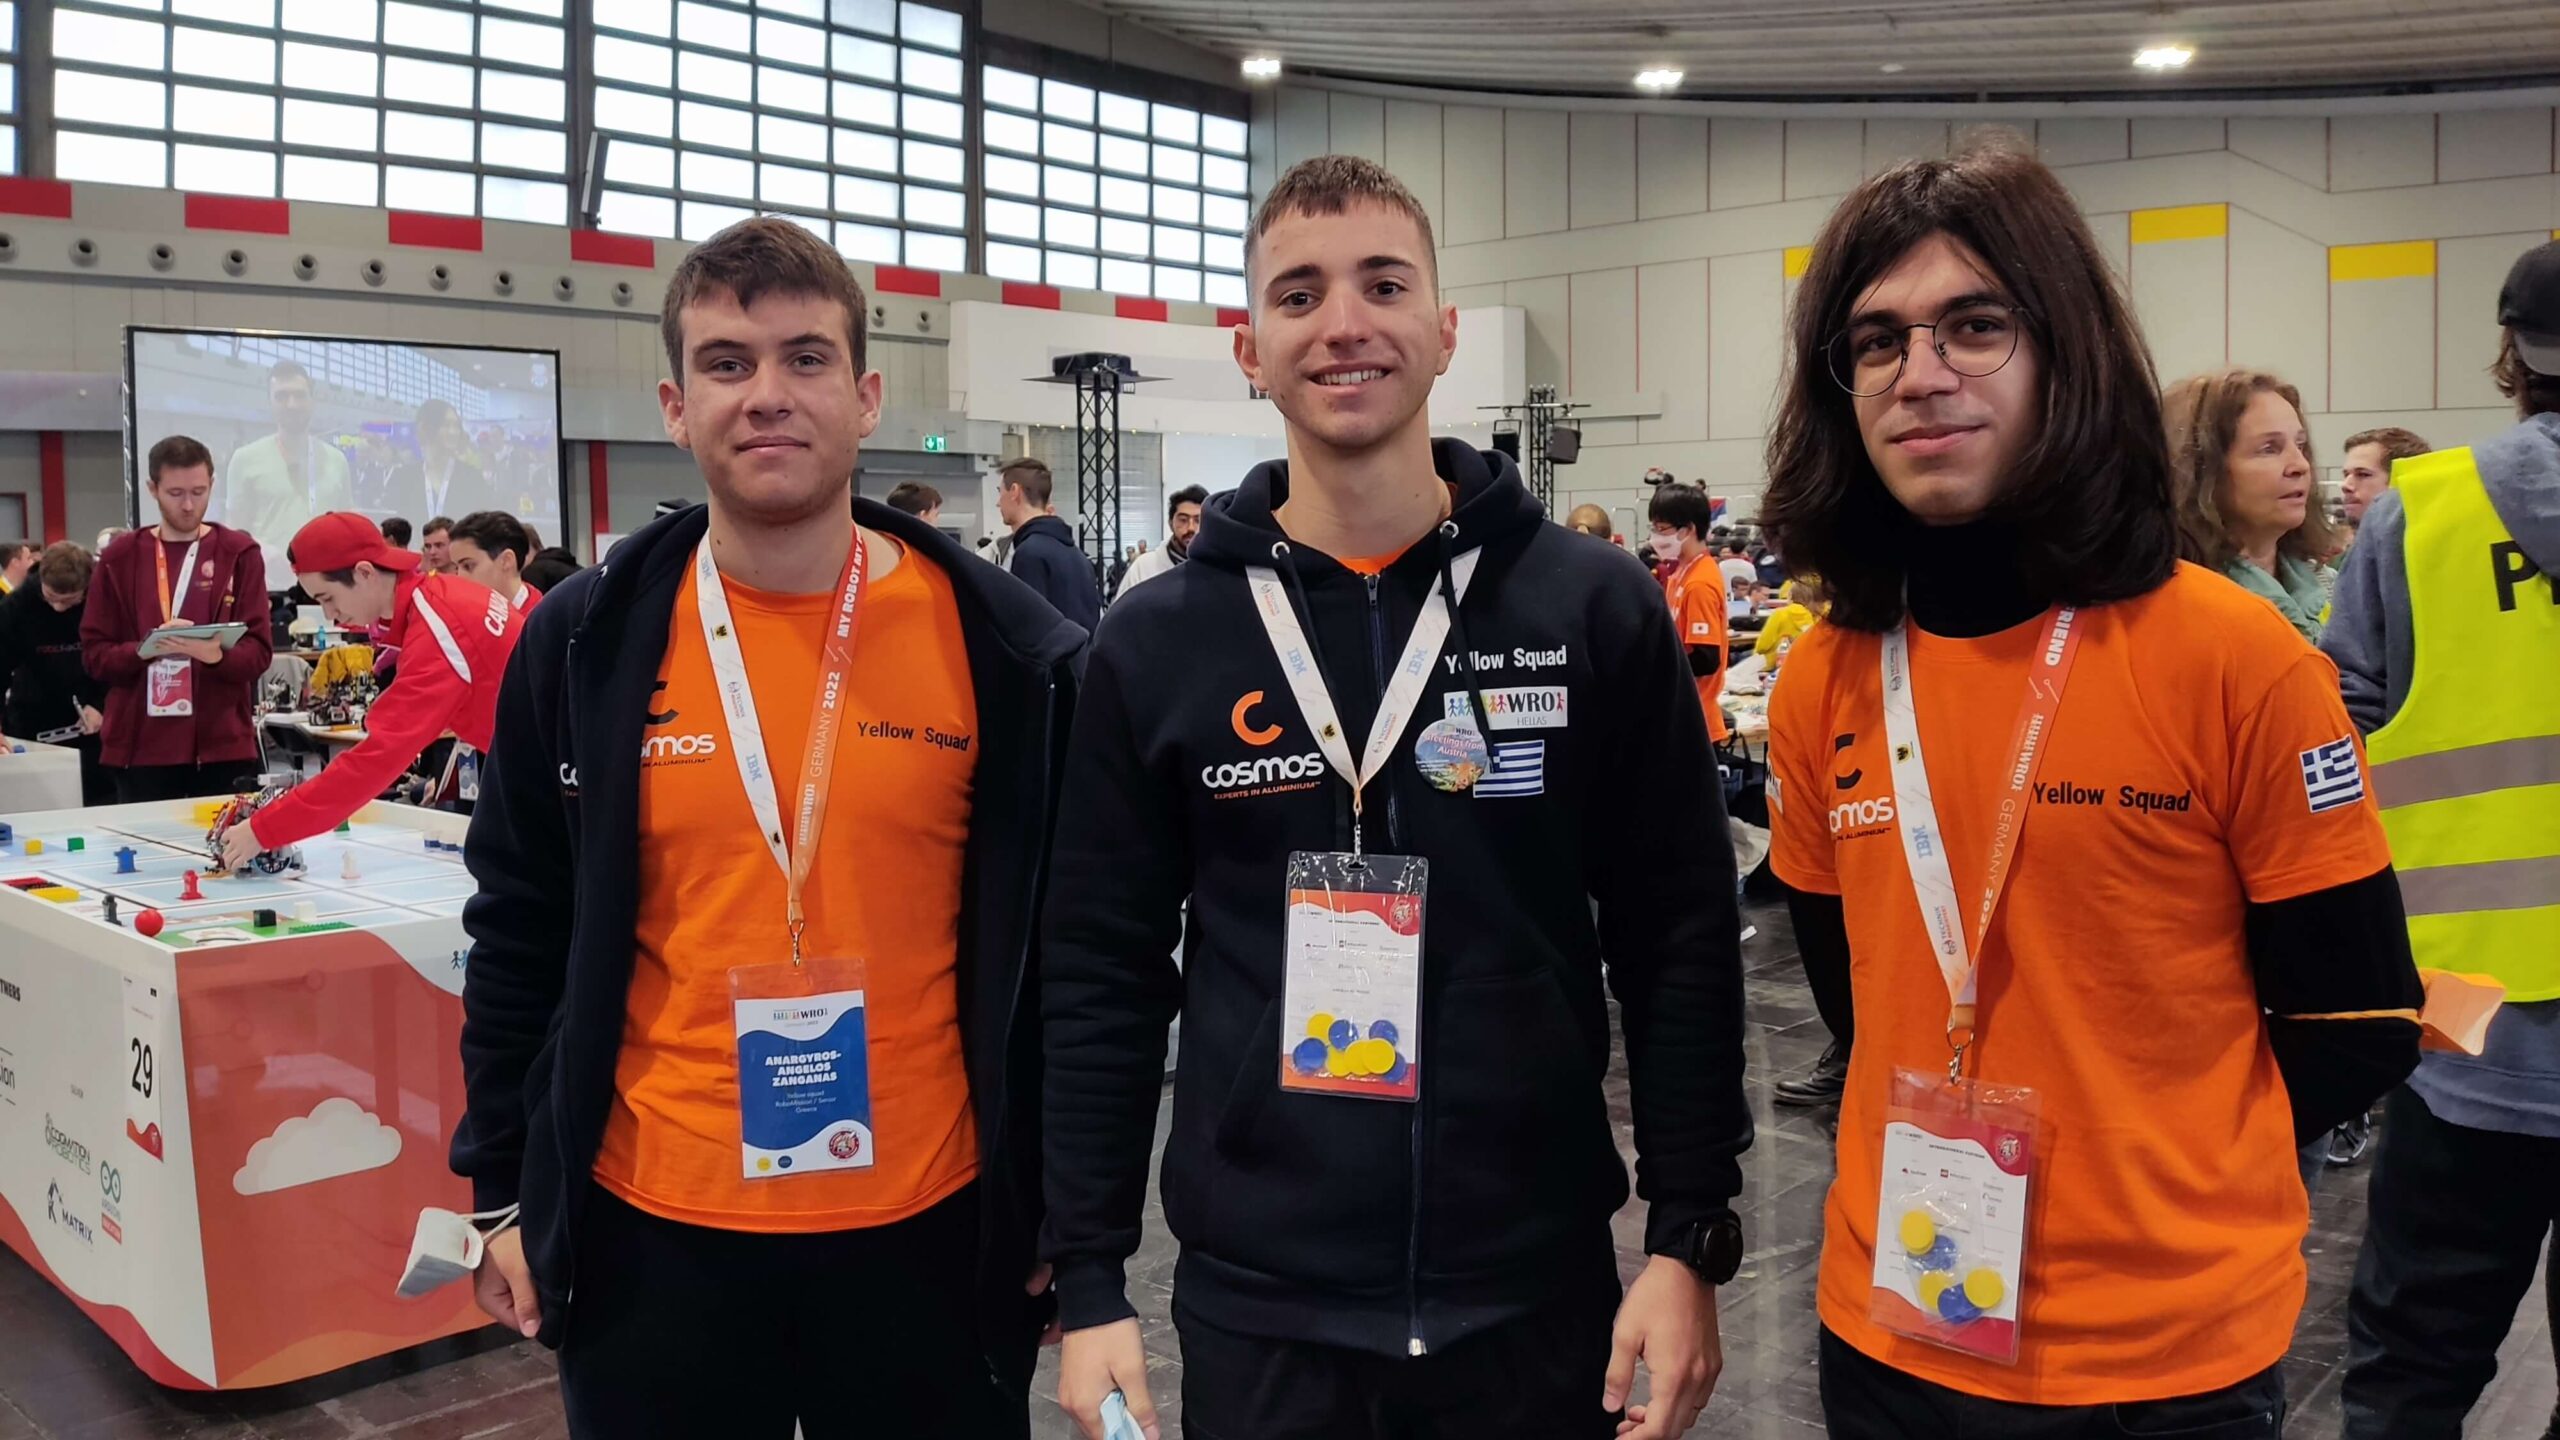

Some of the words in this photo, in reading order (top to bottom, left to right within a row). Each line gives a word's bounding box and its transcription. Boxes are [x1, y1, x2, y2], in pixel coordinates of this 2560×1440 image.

[842, 565, 860, 613] ROBOT
[837, 613, 851, 638] MY
[1288, 647, 1307, 675] IBM
[1407, 648, 1427, 676] IBM
[1513, 644, 1567, 671] Squad
[822, 671, 840, 710] 2022
[1506, 691, 1555, 713] WRO
[1517, 716, 1547, 726] HELLAS
[641, 734, 717, 757] mos
[809, 711, 833, 777] GERMANY
[857, 721, 914, 740] Yellow
[924, 727, 971, 751] Squad
[1437, 746, 1468, 758] Austria
[746, 753, 762, 782] IBM
[1214, 790, 1249, 799] EXPERTS
[2033, 781, 2105, 805] Yellow
[2119, 785, 2191, 814] Squad
[1912, 825, 1932, 859] IBM
[1988, 798, 2016, 883] GERMANY
[800, 1009, 824, 1020] WRO
[132, 1037, 152, 1098] 29
[765, 1050, 842, 1066] ANARGYROS-
[777, 1062, 831, 1075] ANGELOS
[772, 1071, 837, 1087] ZANGANAS
[62, 1208, 93, 1245] MATRIX
